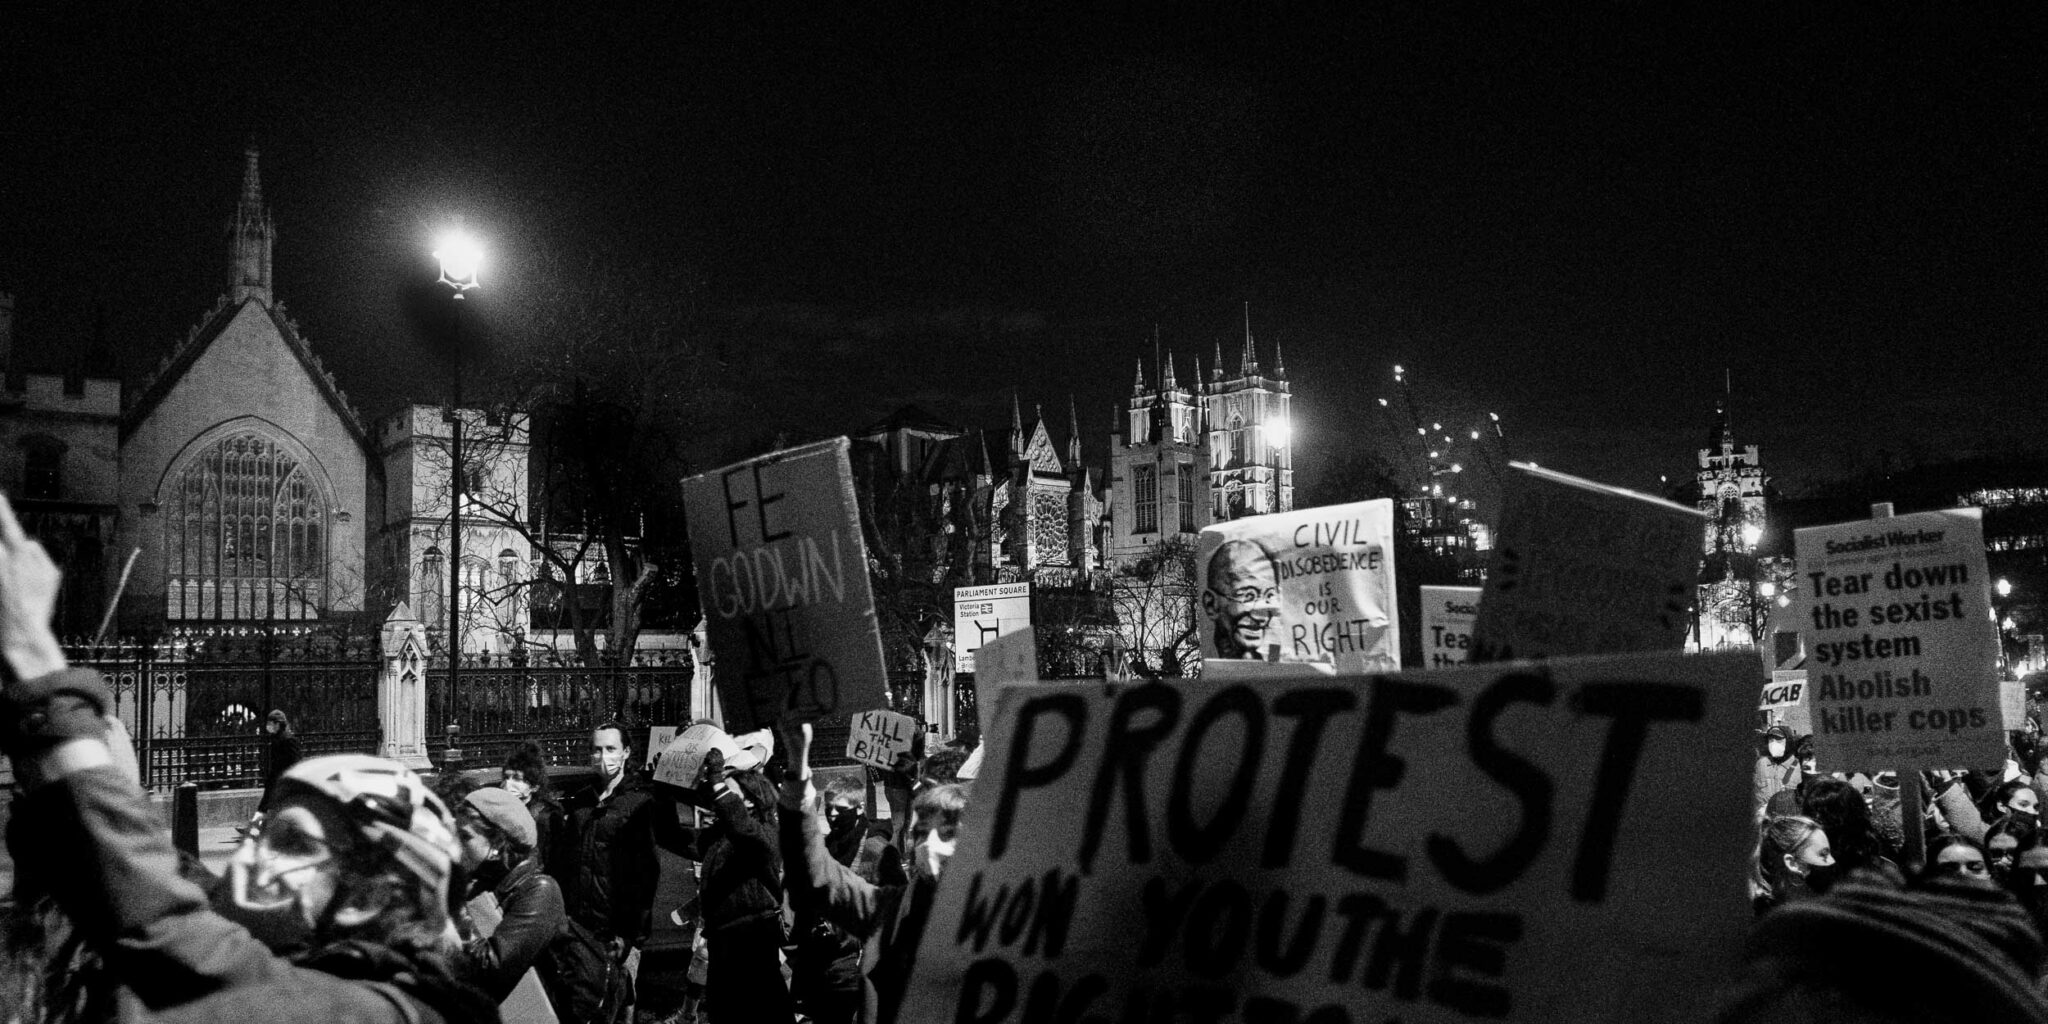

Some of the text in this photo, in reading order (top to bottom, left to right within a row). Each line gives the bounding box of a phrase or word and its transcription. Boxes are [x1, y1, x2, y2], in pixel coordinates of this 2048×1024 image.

[722, 456, 792, 547] FE
[1293, 519, 1368, 548] CIVIL
[710, 529, 845, 619] GODWN
[1319, 581, 1333, 598] IS
[1808, 563, 1969, 597] Tear down
[957, 585, 1027, 597] PARLIAMENT SQUARE
[959, 602, 980, 610] Victoria
[1305, 597, 1341, 616] OUR
[1812, 592, 1965, 630] the sexist
[743, 605, 810, 671] NI
[1292, 619, 1370, 657] RIGHT
[1431, 626, 1469, 649] Tea
[1815, 633, 1921, 667] system
[1761, 684, 1802, 706] ACAB
[1819, 668, 1932, 700] Abolish
[860, 711, 903, 743] KILL
[1821, 705, 1897, 735] killer
[1908, 706, 1987, 734] cops
[854, 740, 896, 767] BILL
[869, 733, 891, 749] THE
[989, 671, 1707, 903] PROTEST
[958, 870, 1080, 960] WON
